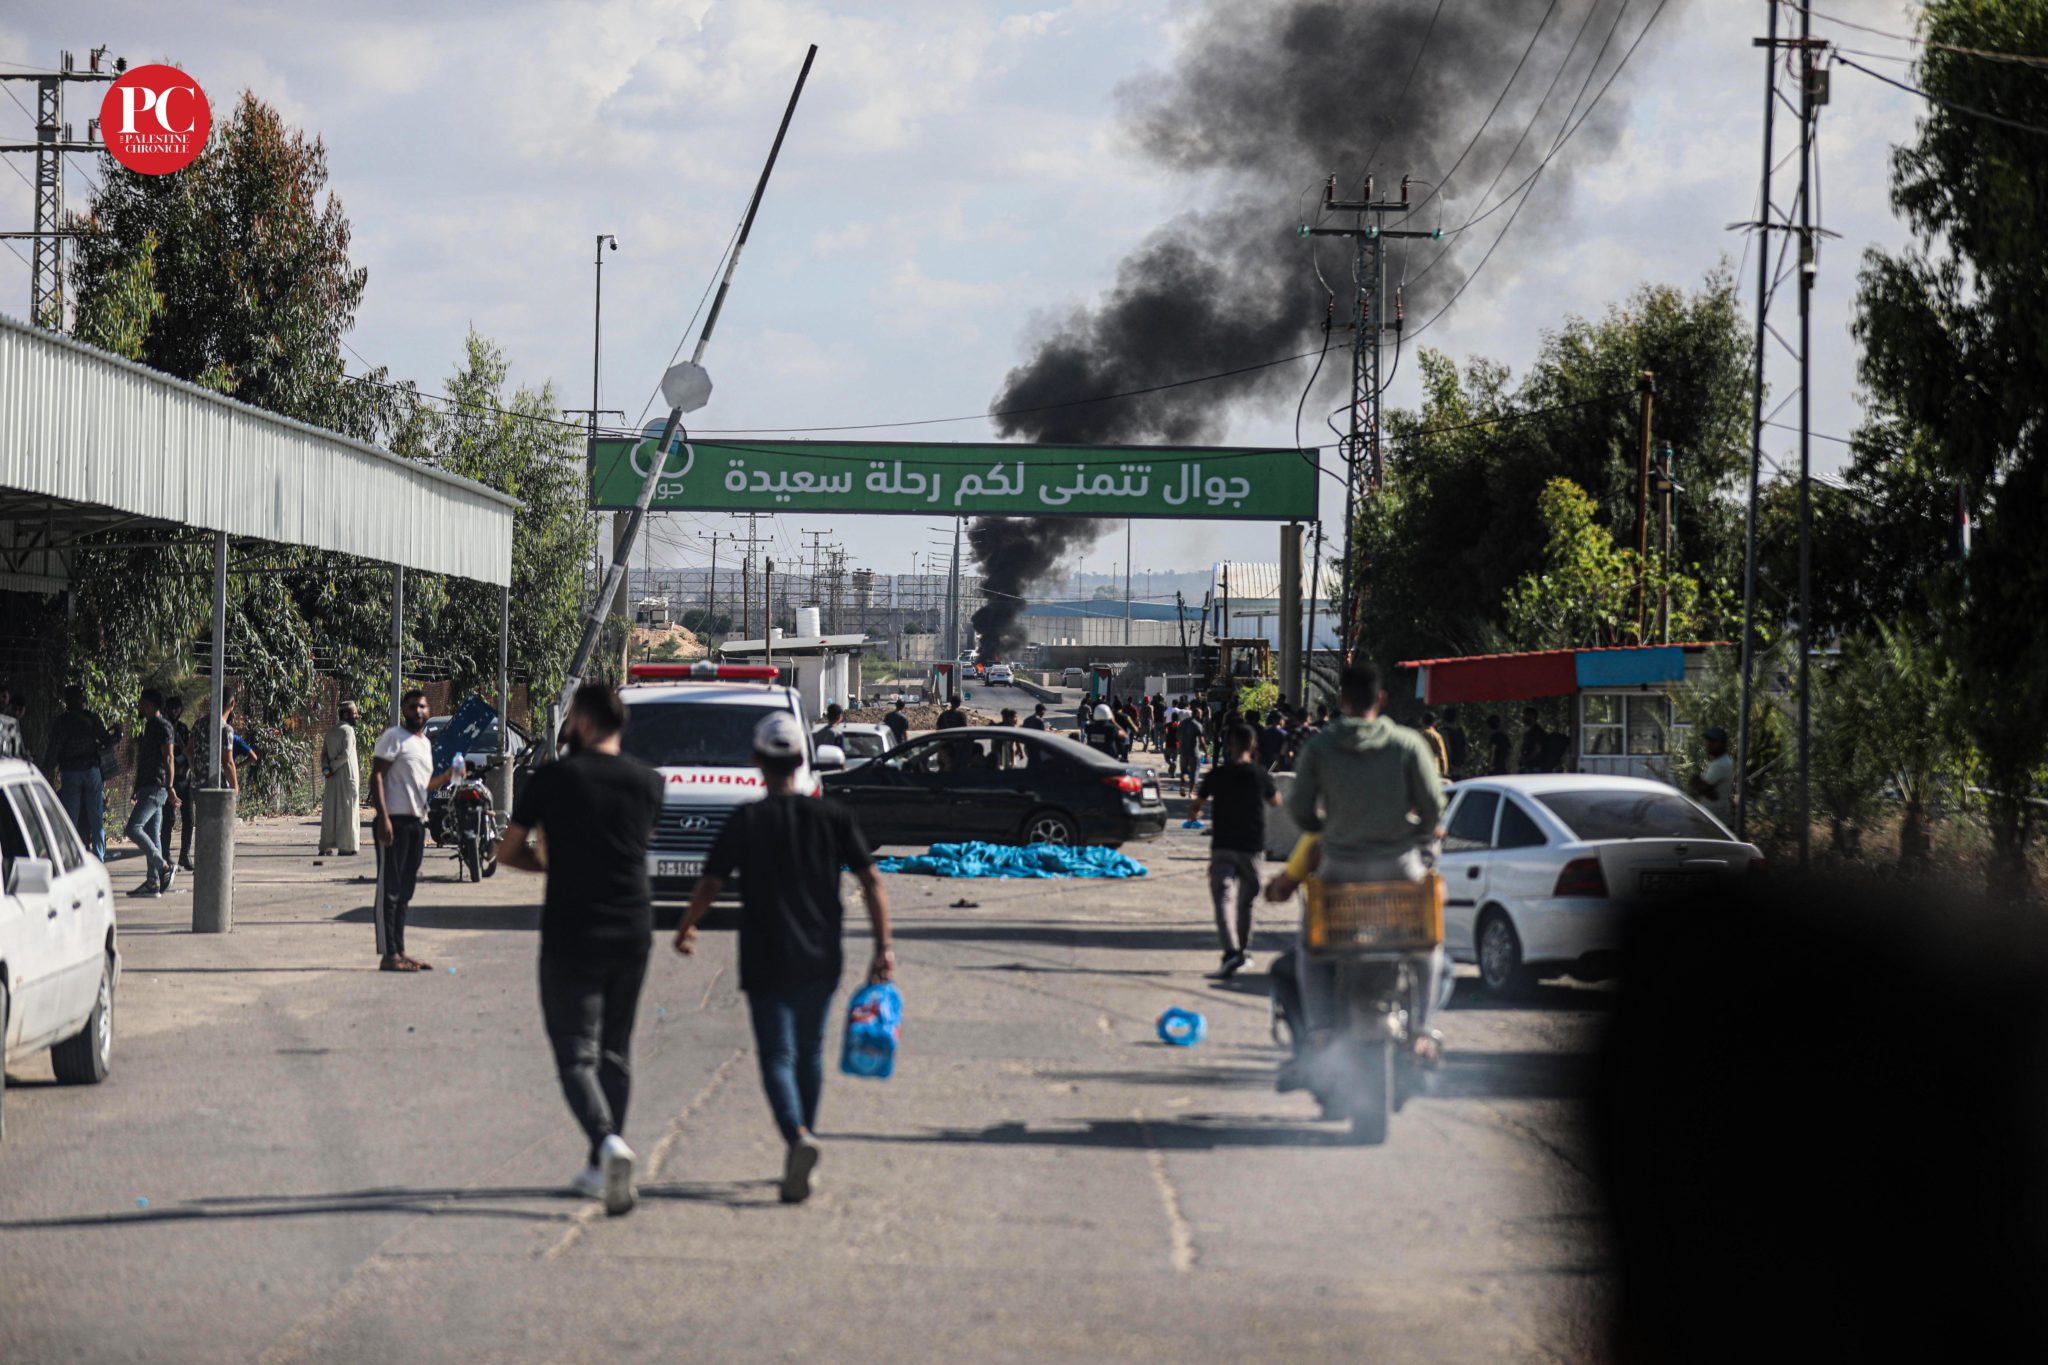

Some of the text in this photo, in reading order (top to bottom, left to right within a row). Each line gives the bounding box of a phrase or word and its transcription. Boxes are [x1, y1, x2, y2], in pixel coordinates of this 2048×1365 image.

[724, 459, 1251, 508] جوال تتمنى لكم رحلة سعيدة
